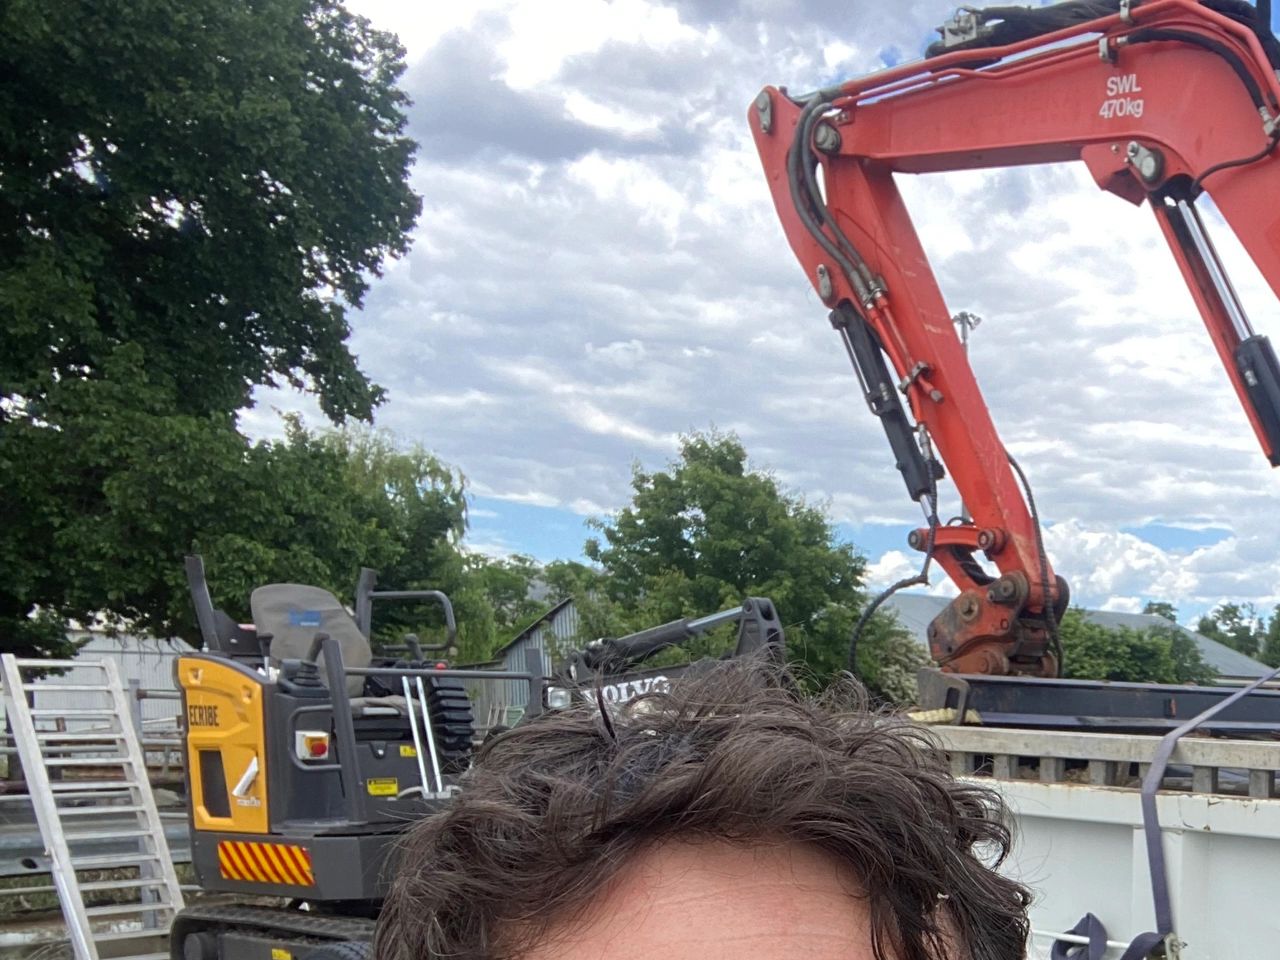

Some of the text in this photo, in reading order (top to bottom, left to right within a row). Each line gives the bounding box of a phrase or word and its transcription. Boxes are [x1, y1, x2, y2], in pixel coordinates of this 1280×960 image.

[1106, 73, 1142, 96] SWL
[1099, 97, 1144, 119] 470kg
[188, 704, 220, 727] ECR18E
